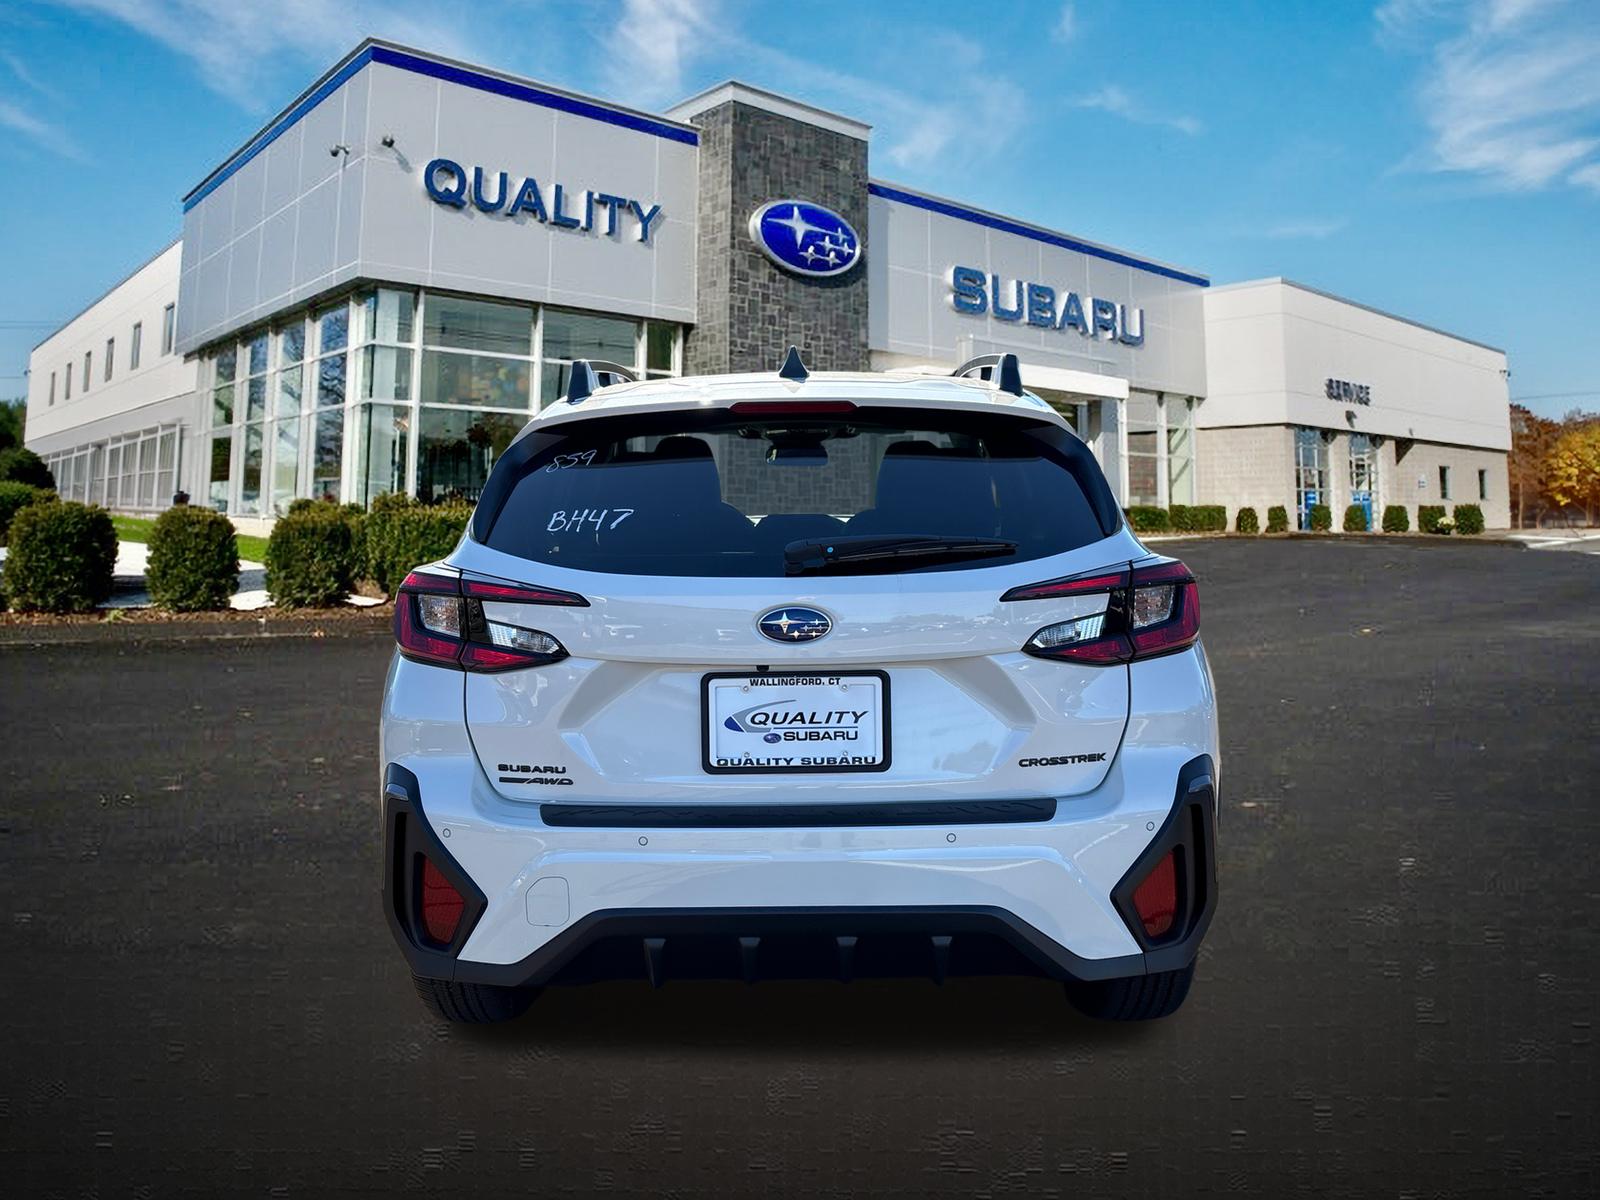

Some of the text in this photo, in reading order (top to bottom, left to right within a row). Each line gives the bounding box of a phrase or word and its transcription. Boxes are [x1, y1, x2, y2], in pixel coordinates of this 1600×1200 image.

[426, 158, 660, 242] QUALITY
[951, 265, 1145, 346] SUBARU
[546, 449, 597, 472] 859
[547, 508, 634, 532] BH47
[828, 677, 841, 686] CT
[750, 711, 869, 725] QUALITY
[783, 731, 858, 741] SUBARU
[716, 756, 876, 767] QUALITY SUBARU
[1019, 752, 1107, 767] CROSSTREK
[498, 764, 566, 774] SUBARU
[526, 777, 574, 785] AWD
